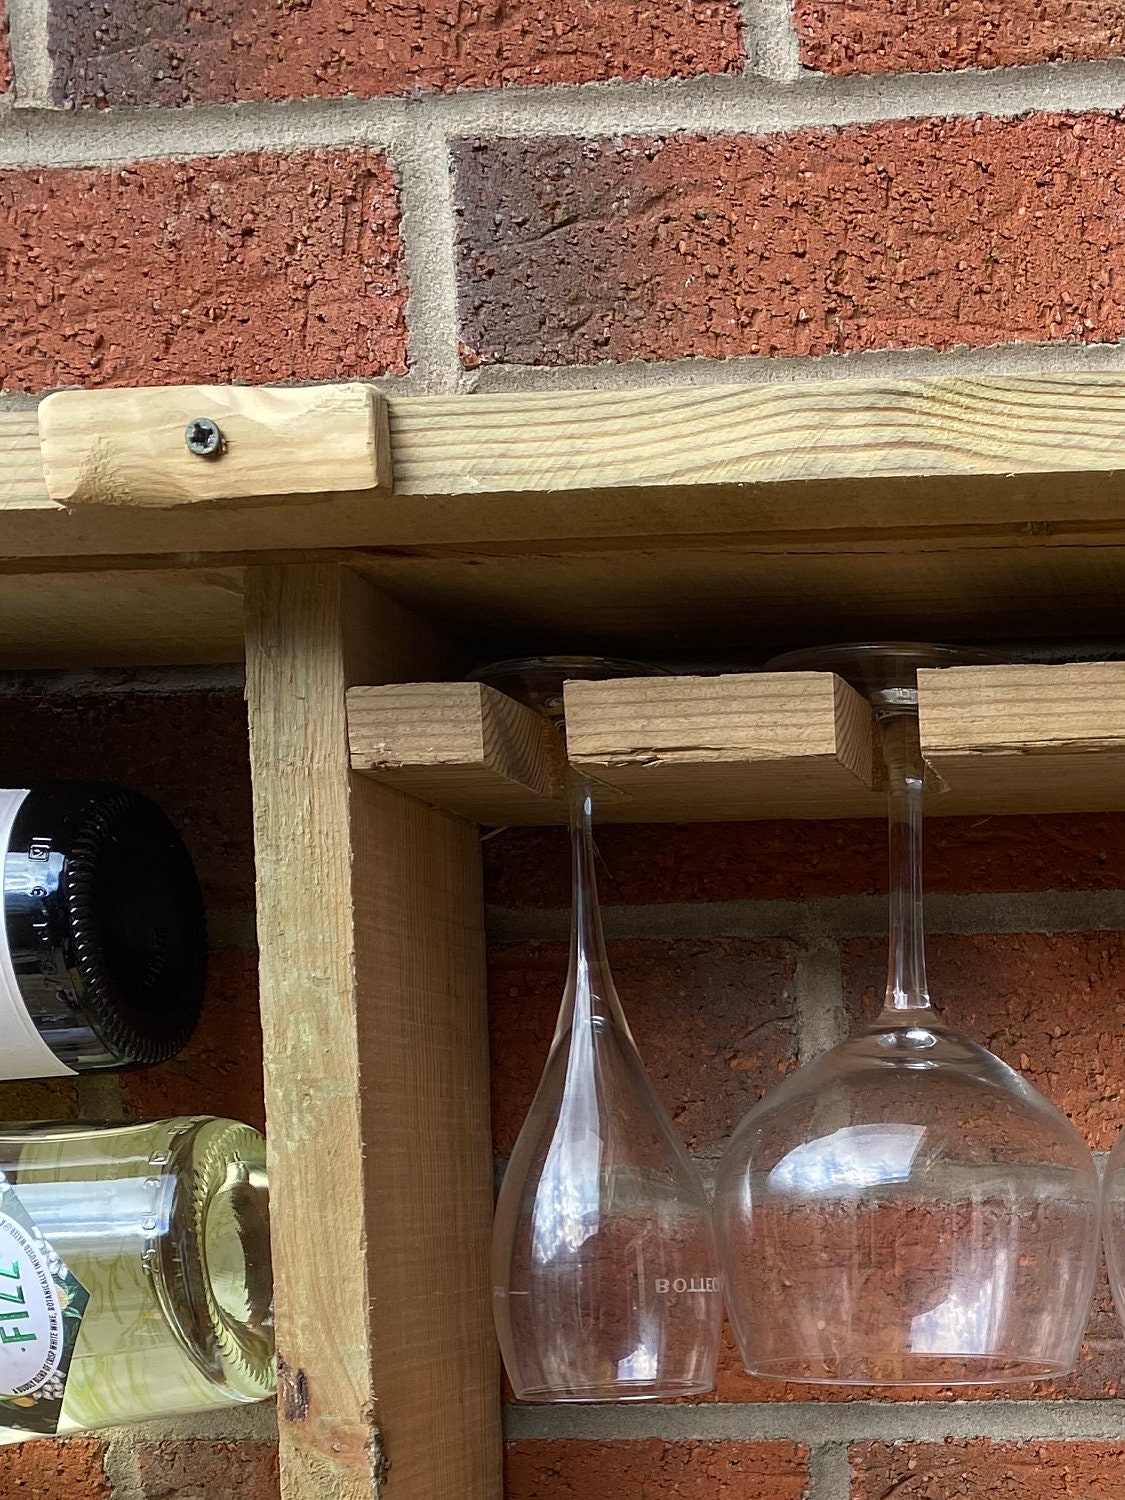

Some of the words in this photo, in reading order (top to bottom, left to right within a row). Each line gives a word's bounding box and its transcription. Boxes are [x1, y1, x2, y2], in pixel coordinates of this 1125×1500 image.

[12, 1227, 27, 1247] WATER
[24, 1244, 42, 1270] INFUSED
[37, 1270, 55, 1311] BOTANICALLY
[50, 1333, 58, 1350] WHITE
[45, 1351, 56, 1365] CRISP
